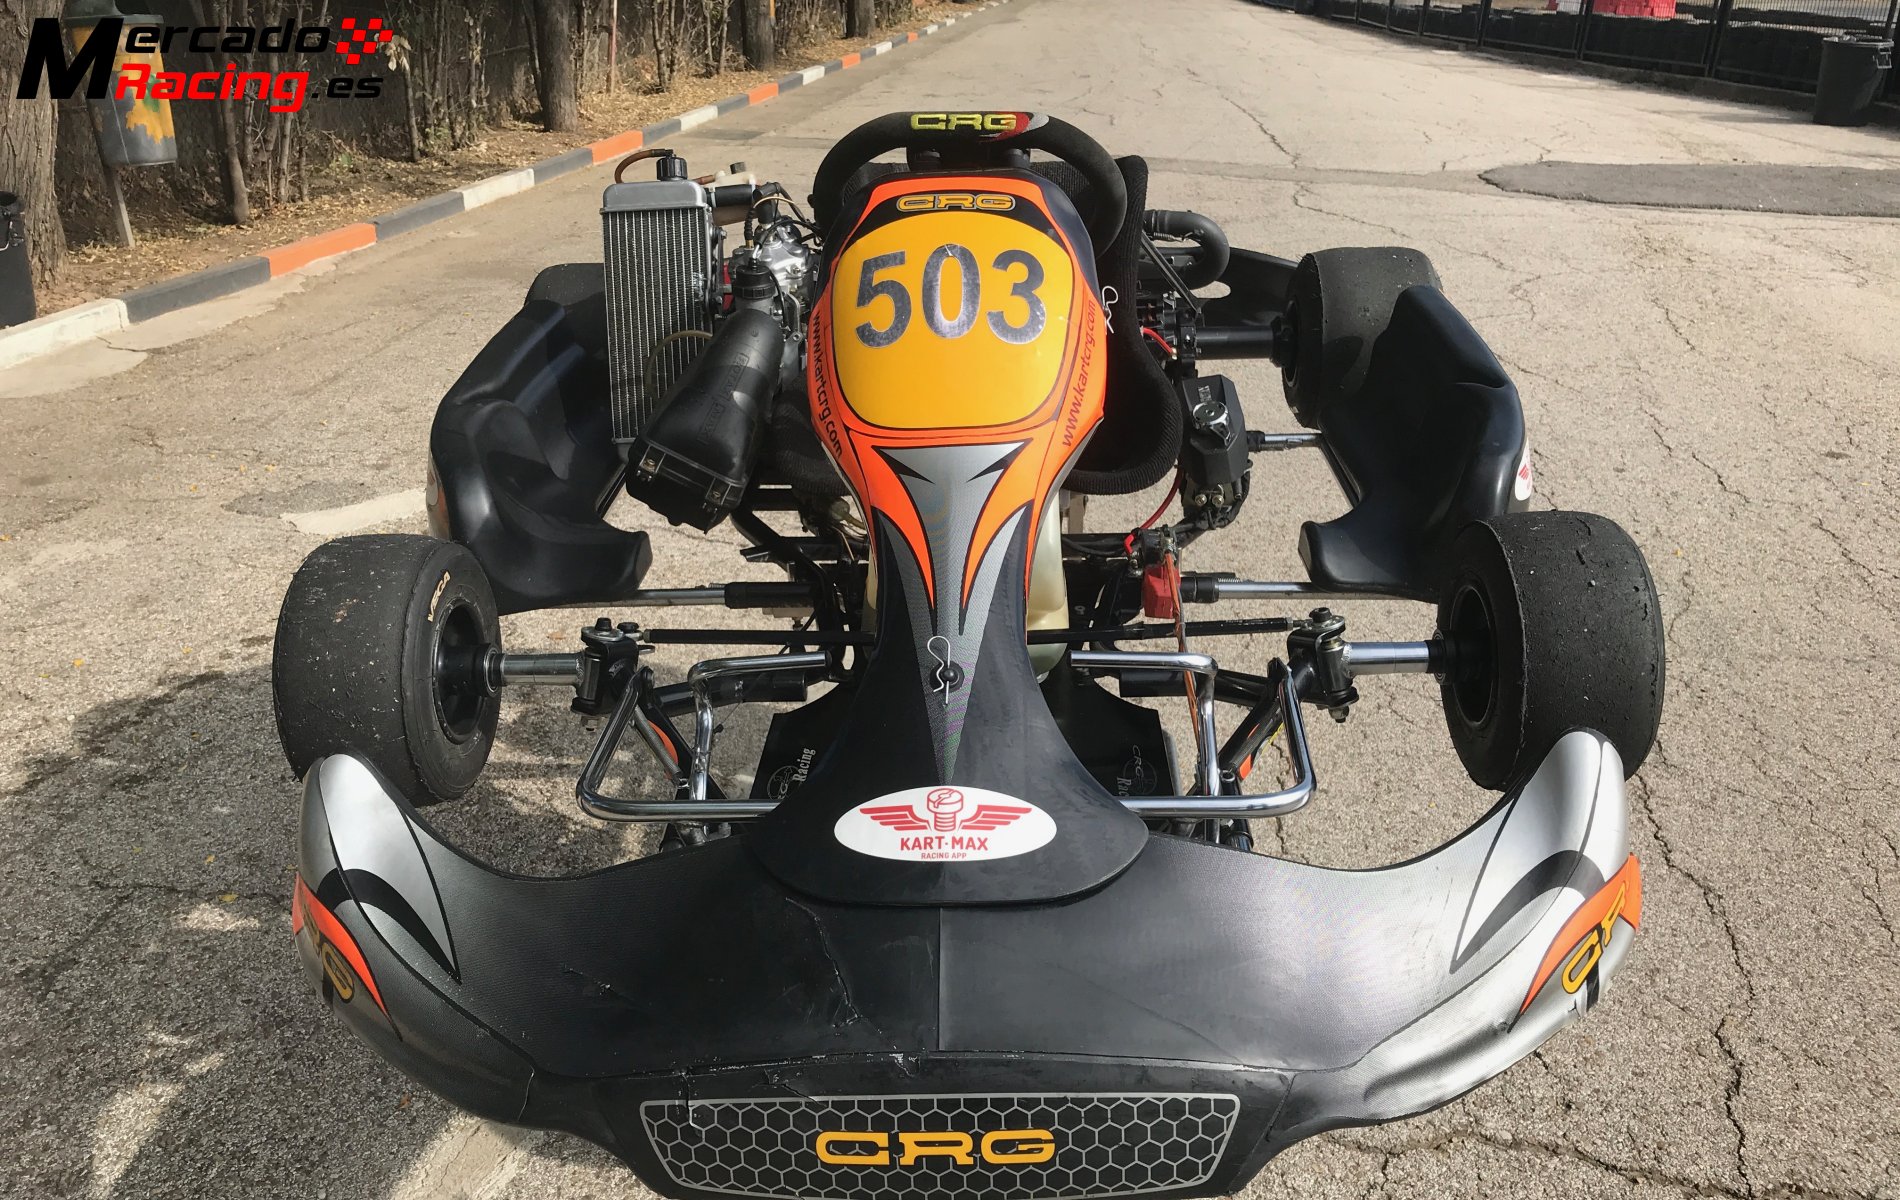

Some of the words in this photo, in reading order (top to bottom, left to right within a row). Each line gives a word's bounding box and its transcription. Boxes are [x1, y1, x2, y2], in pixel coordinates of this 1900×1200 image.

[910, 113, 1017, 131] CRG
[897, 194, 1015, 211] CRG
[855, 243, 1047, 348] 503
[812, 310, 844, 459] www.kartcrg.com
[1062, 299, 1096, 448] www.kartcrg.com
[792, 748, 816, 782] Racing
[1116, 776, 1132, 797] Rac
[921, 852, 950, 860] RACING
[951, 852, 967, 860] APP
[1562, 880, 1628, 994] CR
[815, 1129, 1056, 1165] CRG
